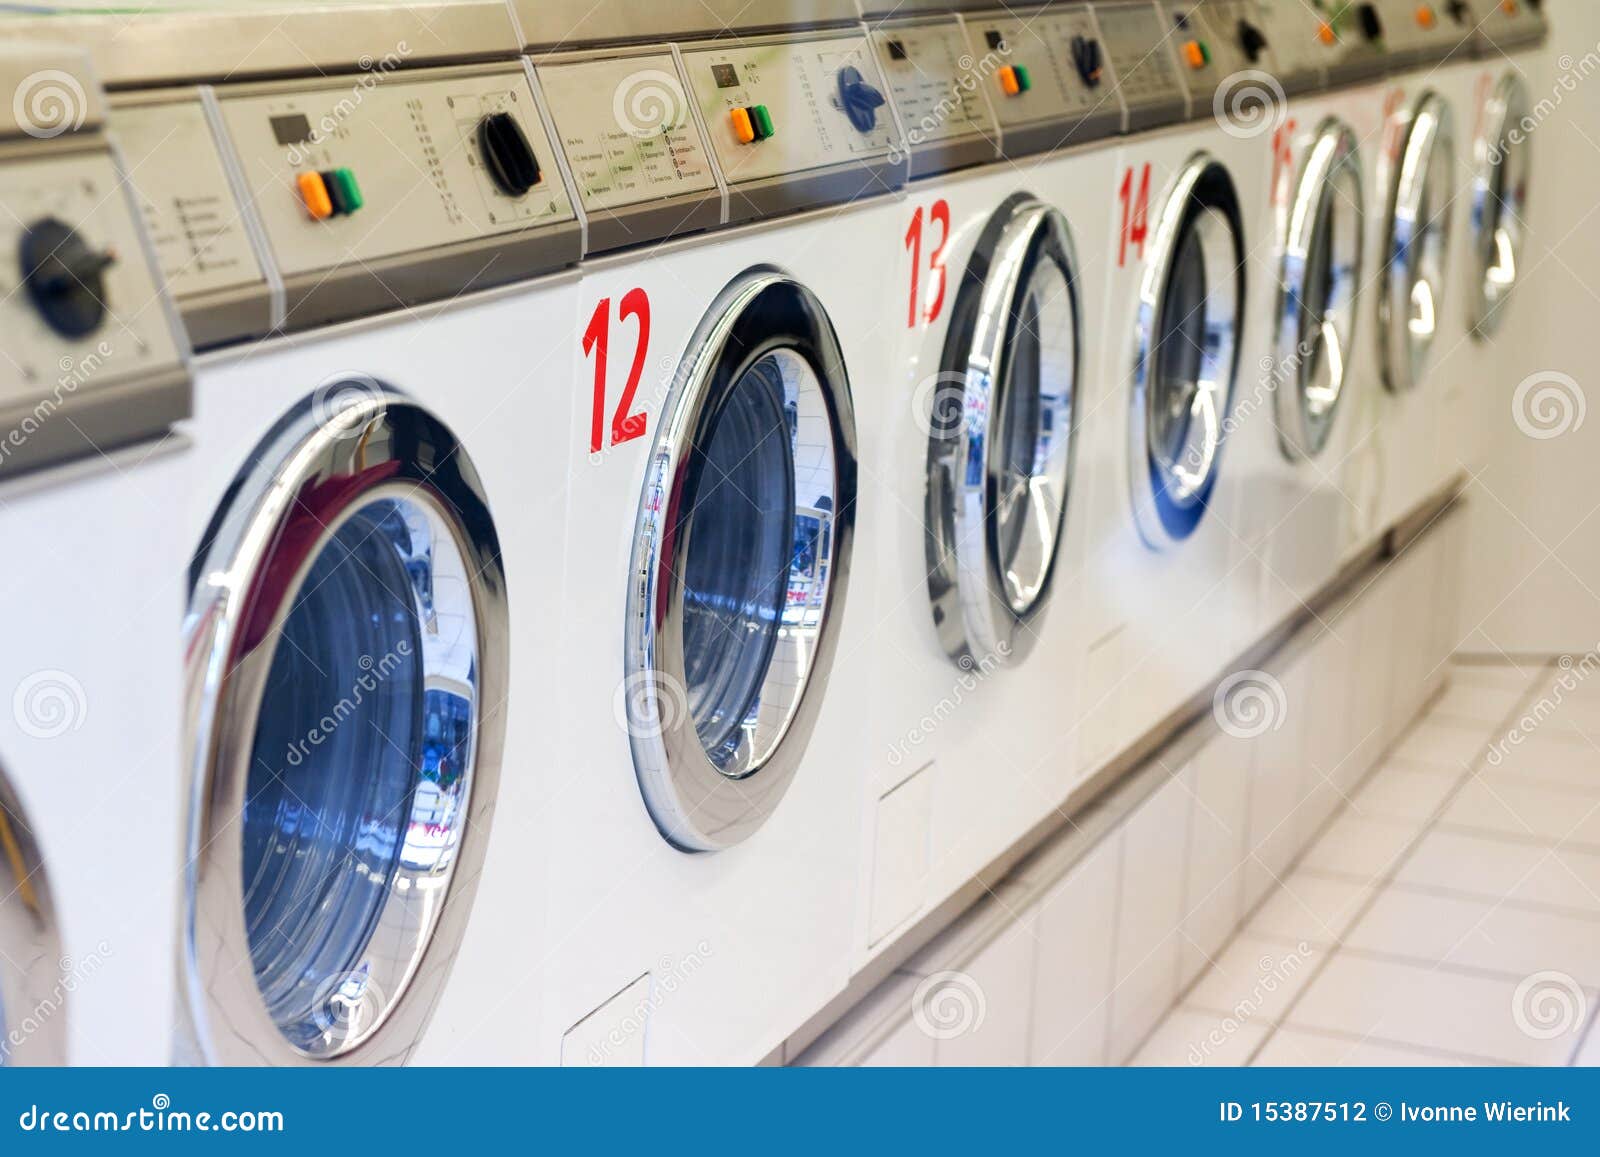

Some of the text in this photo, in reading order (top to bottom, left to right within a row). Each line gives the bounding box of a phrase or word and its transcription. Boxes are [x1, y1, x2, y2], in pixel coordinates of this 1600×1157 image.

[905, 198, 950, 329] 13
[1119, 161, 1151, 267] 14
[582, 287, 650, 454] 12
